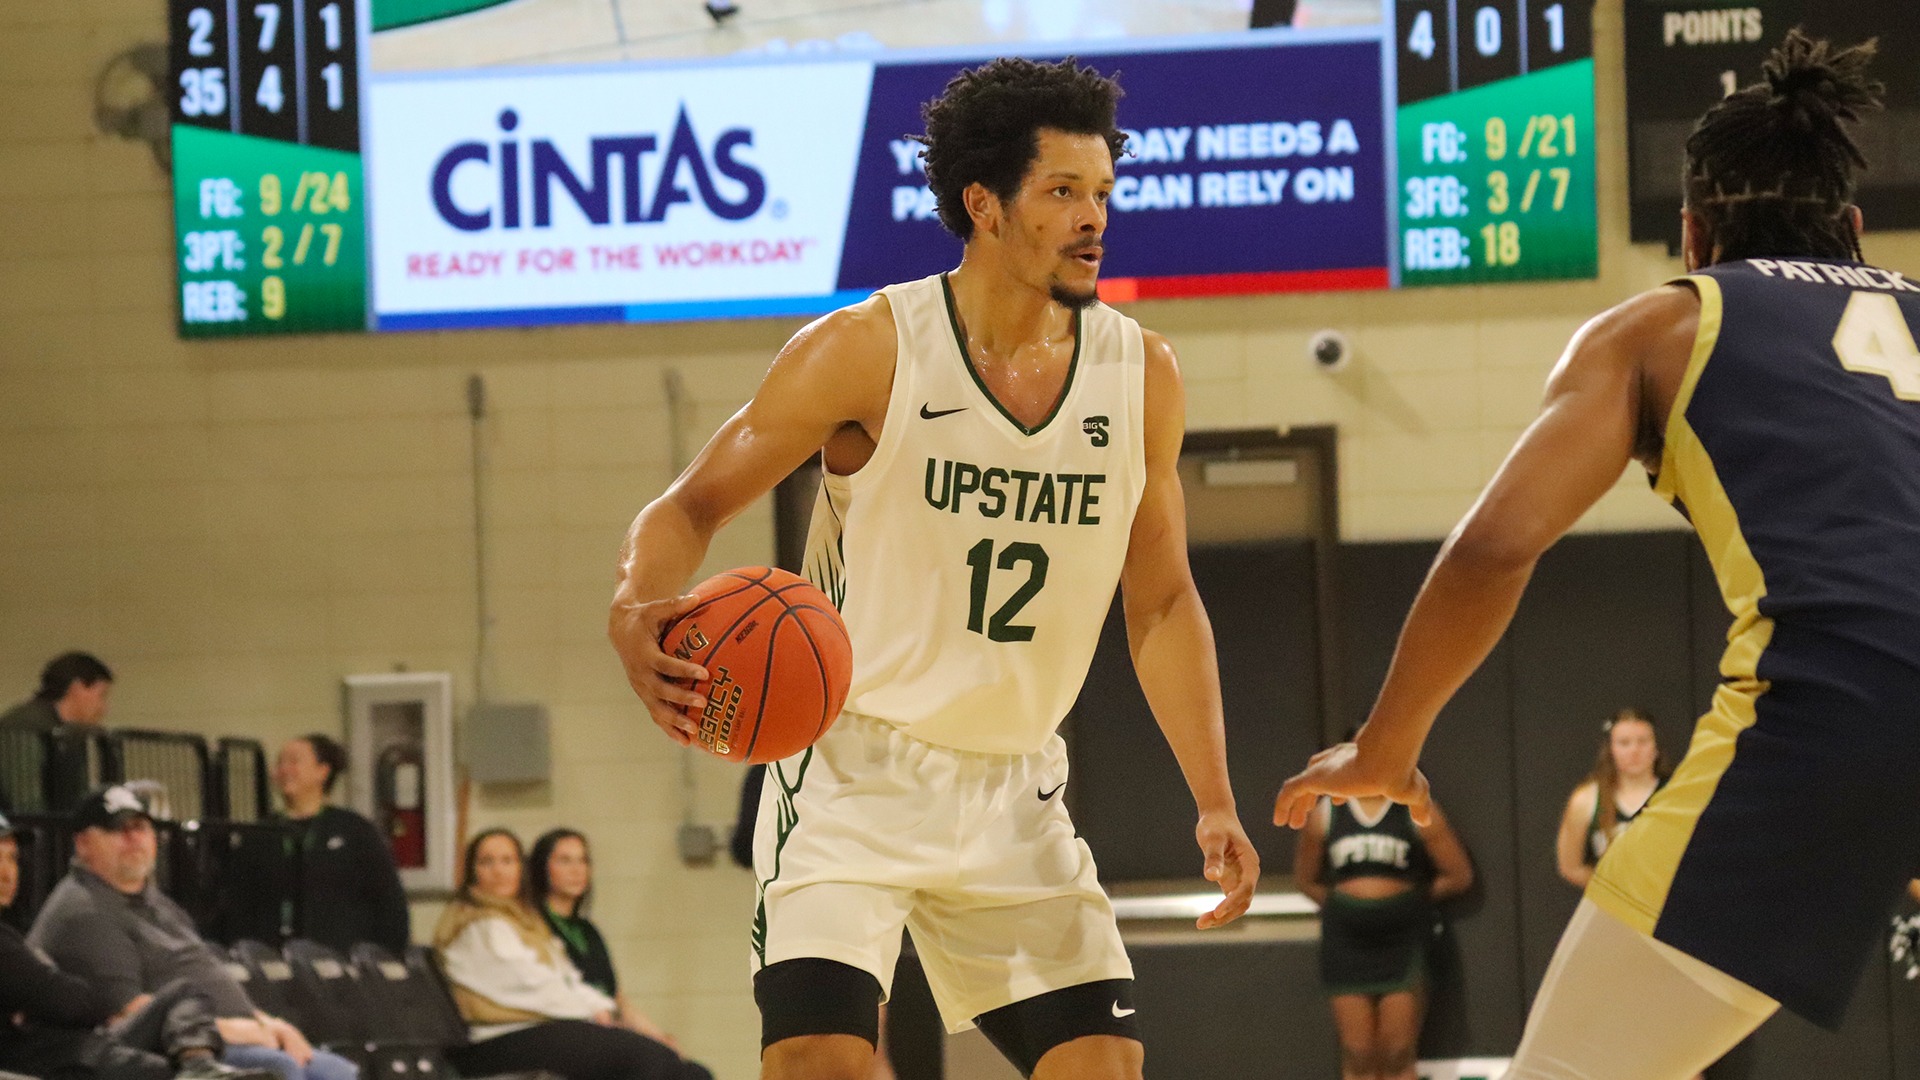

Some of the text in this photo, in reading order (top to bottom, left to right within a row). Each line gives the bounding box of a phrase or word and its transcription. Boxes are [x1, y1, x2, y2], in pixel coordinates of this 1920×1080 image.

[187, 2, 341, 56] 2 7 1
[1408, 3, 1565, 60] 4 0 1
[1662, 7, 1764, 47] POINTS
[179, 62, 343, 117] 35 4 1
[1196, 119, 1324, 162] NEEDS
[1326, 118, 1361, 156] A
[1421, 121, 1467, 164] FG:
[1484, 116, 1507, 161] 9
[199, 177, 245, 219] FG:
[259, 173, 282, 216] 9
[1110, 172, 1194, 213] CAN
[1198, 168, 1290, 209] RELY
[1292, 164, 1355, 205] ON
[1405, 174, 1469, 219] 3FG:
[1486, 169, 1510, 215] 3
[183, 229, 247, 273] 3PT:
[261, 225, 284, 270] 2
[406, 237, 805, 278] READY FOR THE WORKDAY
[1404, 221, 1521, 270] REB: 18
[1746, 257, 1920, 293] PATRICK
[182, 275, 286, 325] REB: 9
[1831, 289, 1920, 403] 4
[924, 457, 1106, 526] UPSTATE
[966, 538, 1050, 643] 12
